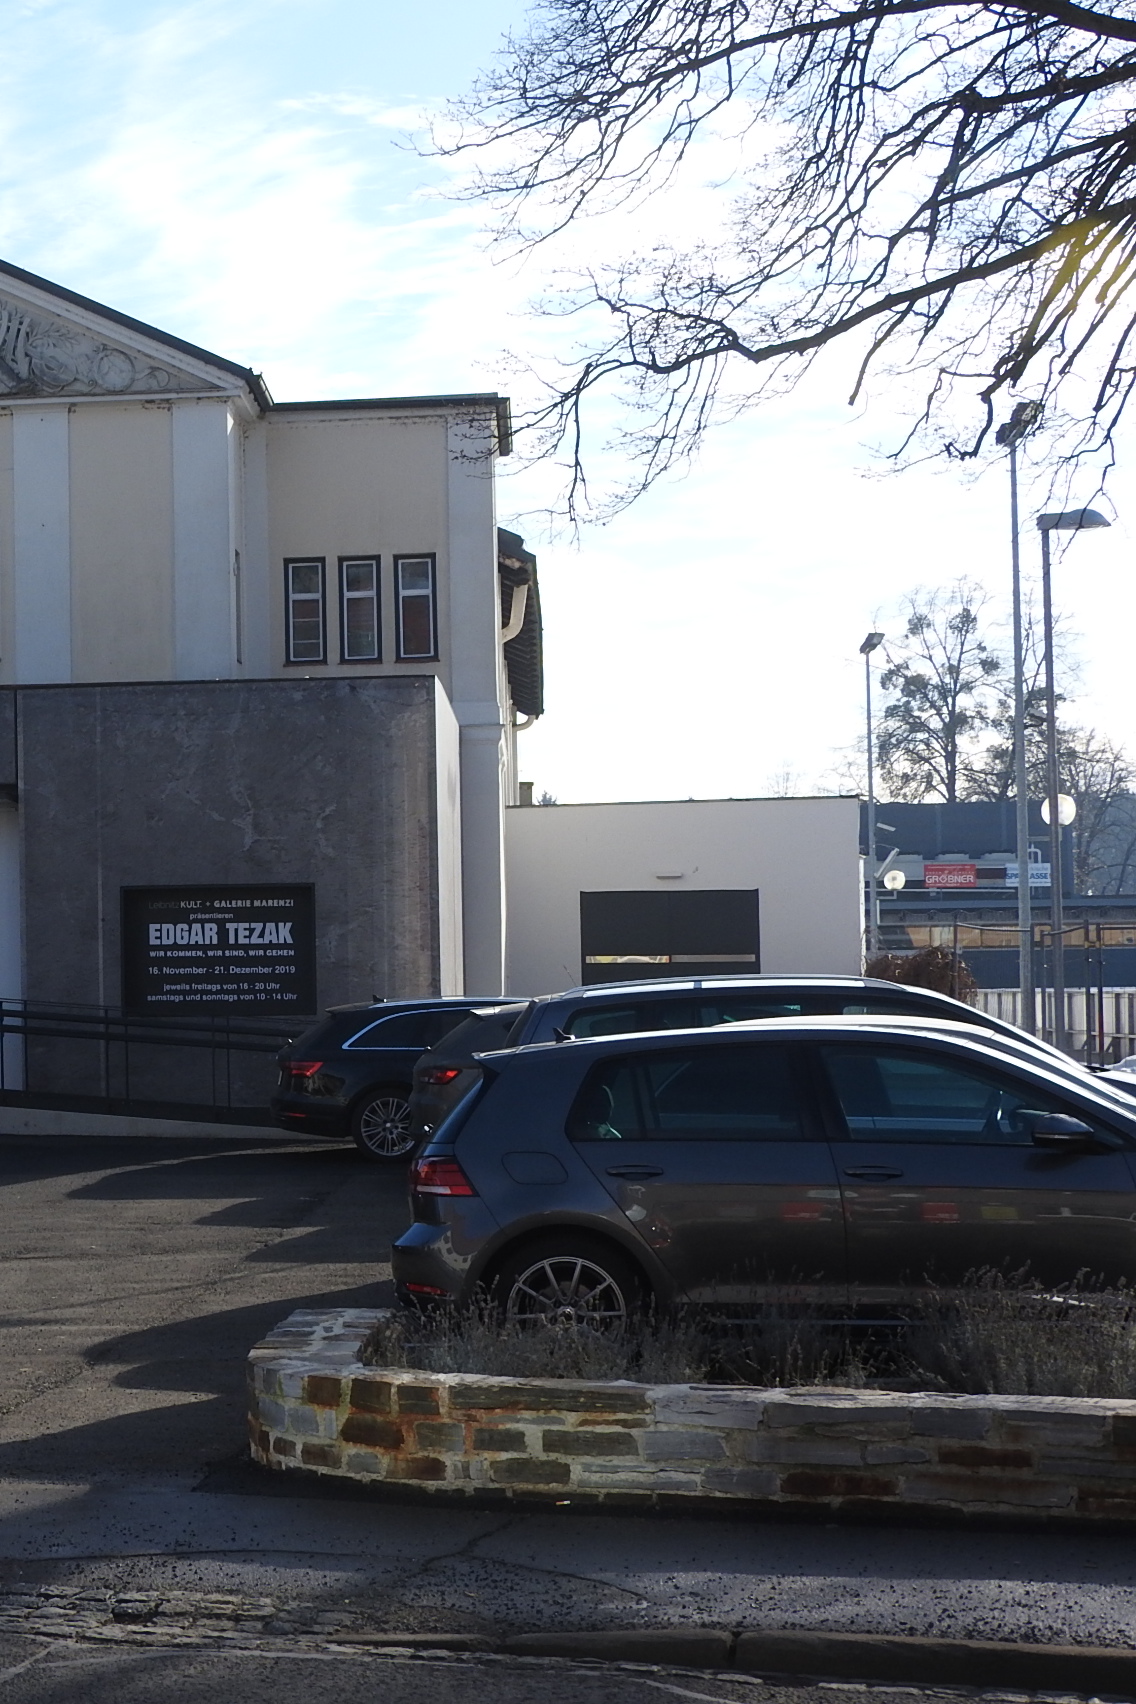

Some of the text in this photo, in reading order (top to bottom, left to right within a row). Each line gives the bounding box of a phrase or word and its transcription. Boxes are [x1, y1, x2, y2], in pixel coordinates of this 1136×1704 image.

[214, 900, 251, 908] GALERIE
[254, 899, 294, 907] MARENZI
[190, 913, 233, 921] präsentieren
[149, 923, 293, 945] EDGAR TEZAK
[149, 967, 160, 975] 16.
[163, 967, 207, 975] November
[215, 966, 227, 974] 21.
[230, 966, 272, 974] Dezember
[275, 966, 295, 974] 2019
[164, 984, 189, 992] jeweils
[192, 983, 220, 991] freitags
[148, 995, 183, 1003] samstags
[203, 994, 237, 1002] sonntags
[257, 993, 265, 1001] 10
[283, 993, 297, 1001] Uhr
